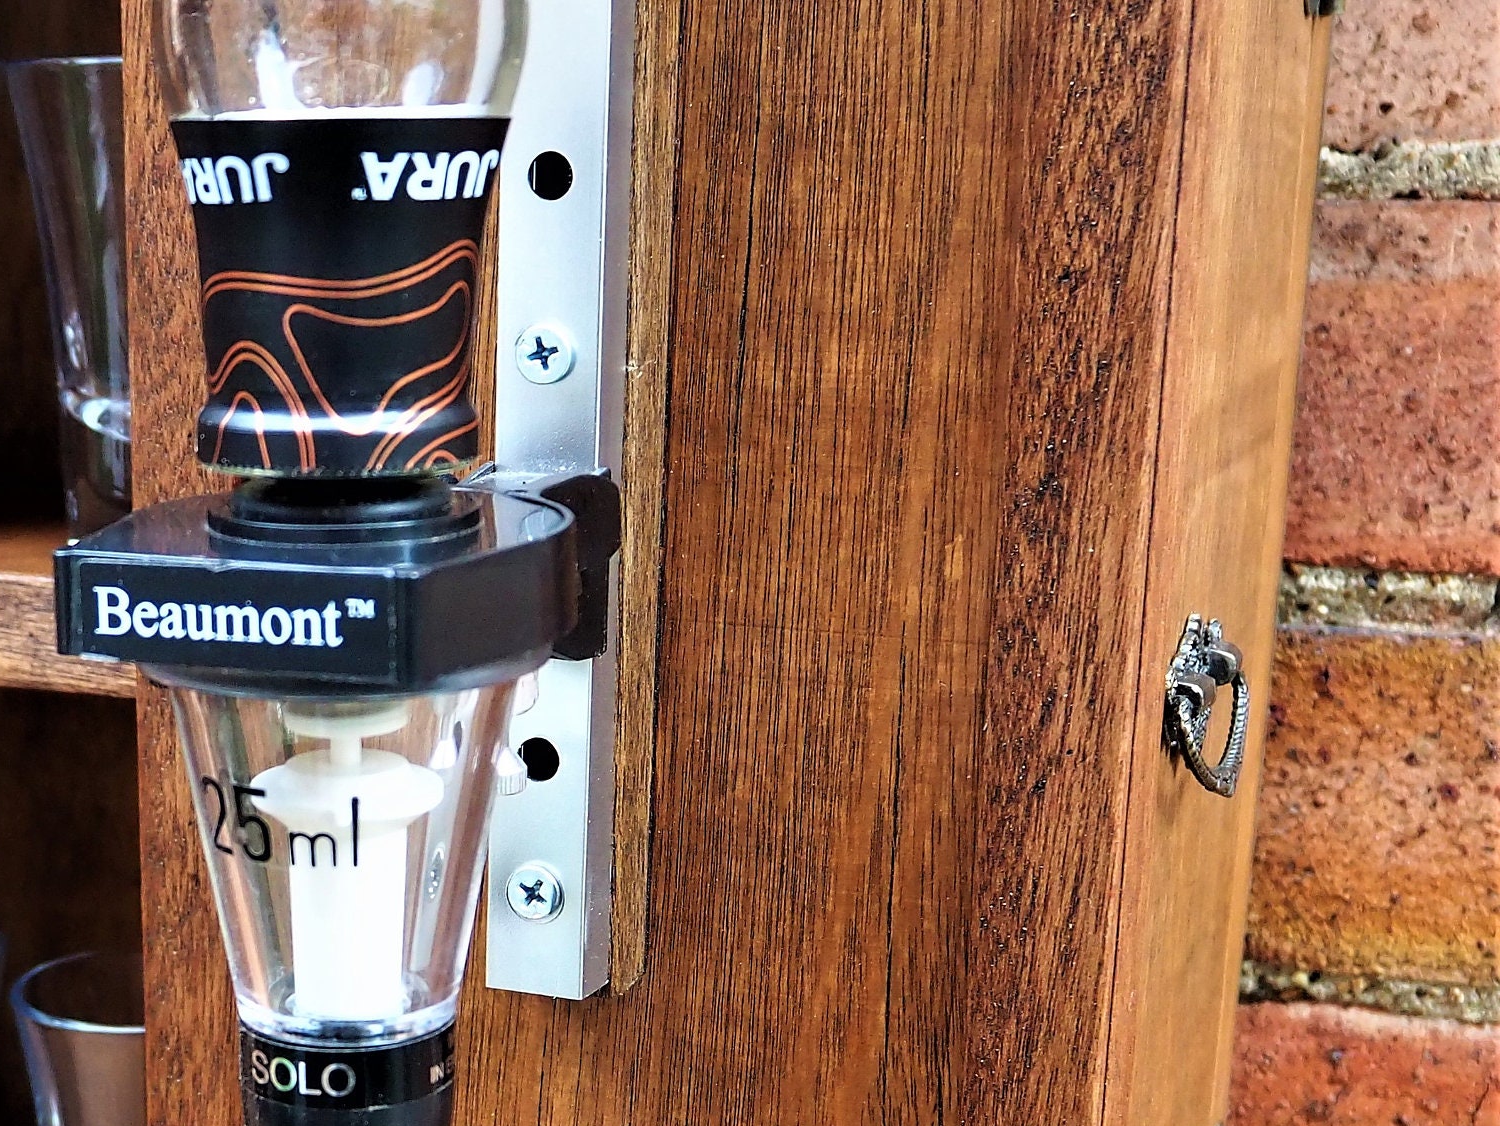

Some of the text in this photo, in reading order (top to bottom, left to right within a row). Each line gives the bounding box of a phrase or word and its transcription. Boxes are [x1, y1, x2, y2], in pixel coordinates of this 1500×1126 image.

[181, 152, 290, 206] JURA
[358, 149, 500, 201] JURA
[92, 584, 344, 648] Beaumont
[200, 774, 358, 868] 25 ml
[251, 1049, 357, 1098] SOLO
